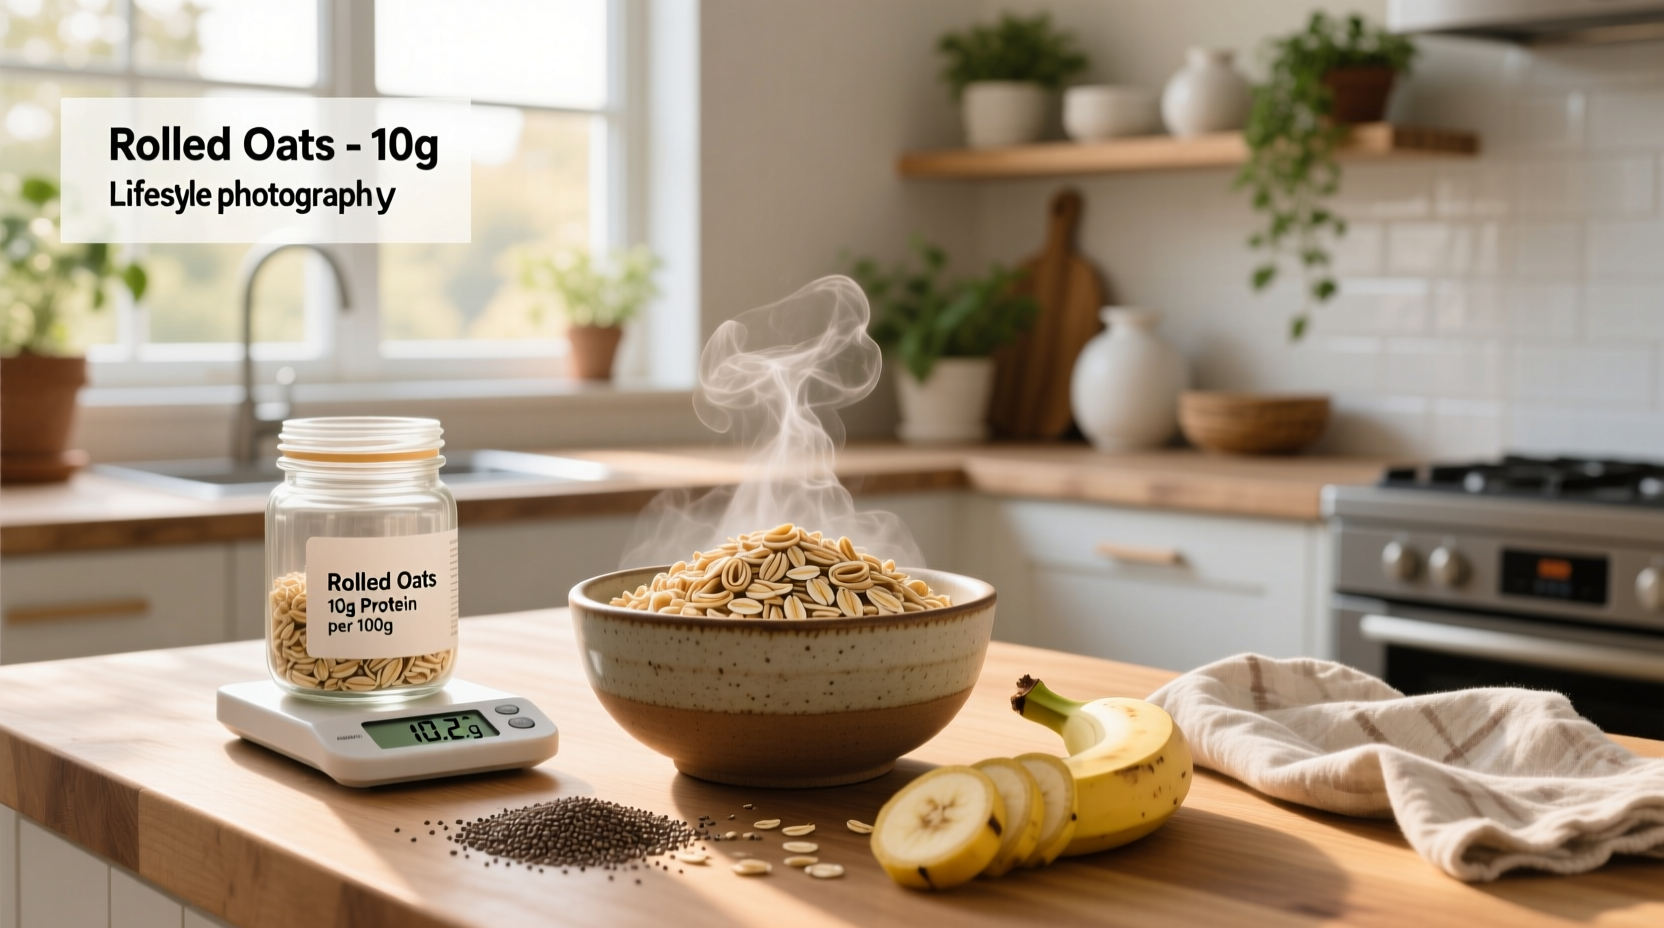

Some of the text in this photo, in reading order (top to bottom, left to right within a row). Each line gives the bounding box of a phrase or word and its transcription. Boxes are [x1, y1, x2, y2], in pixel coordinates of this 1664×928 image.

[328, 570, 437, 592] Rolled Oats
[327, 596, 417, 617] 10g Protein
[328, 618, 393, 636] per 100g
